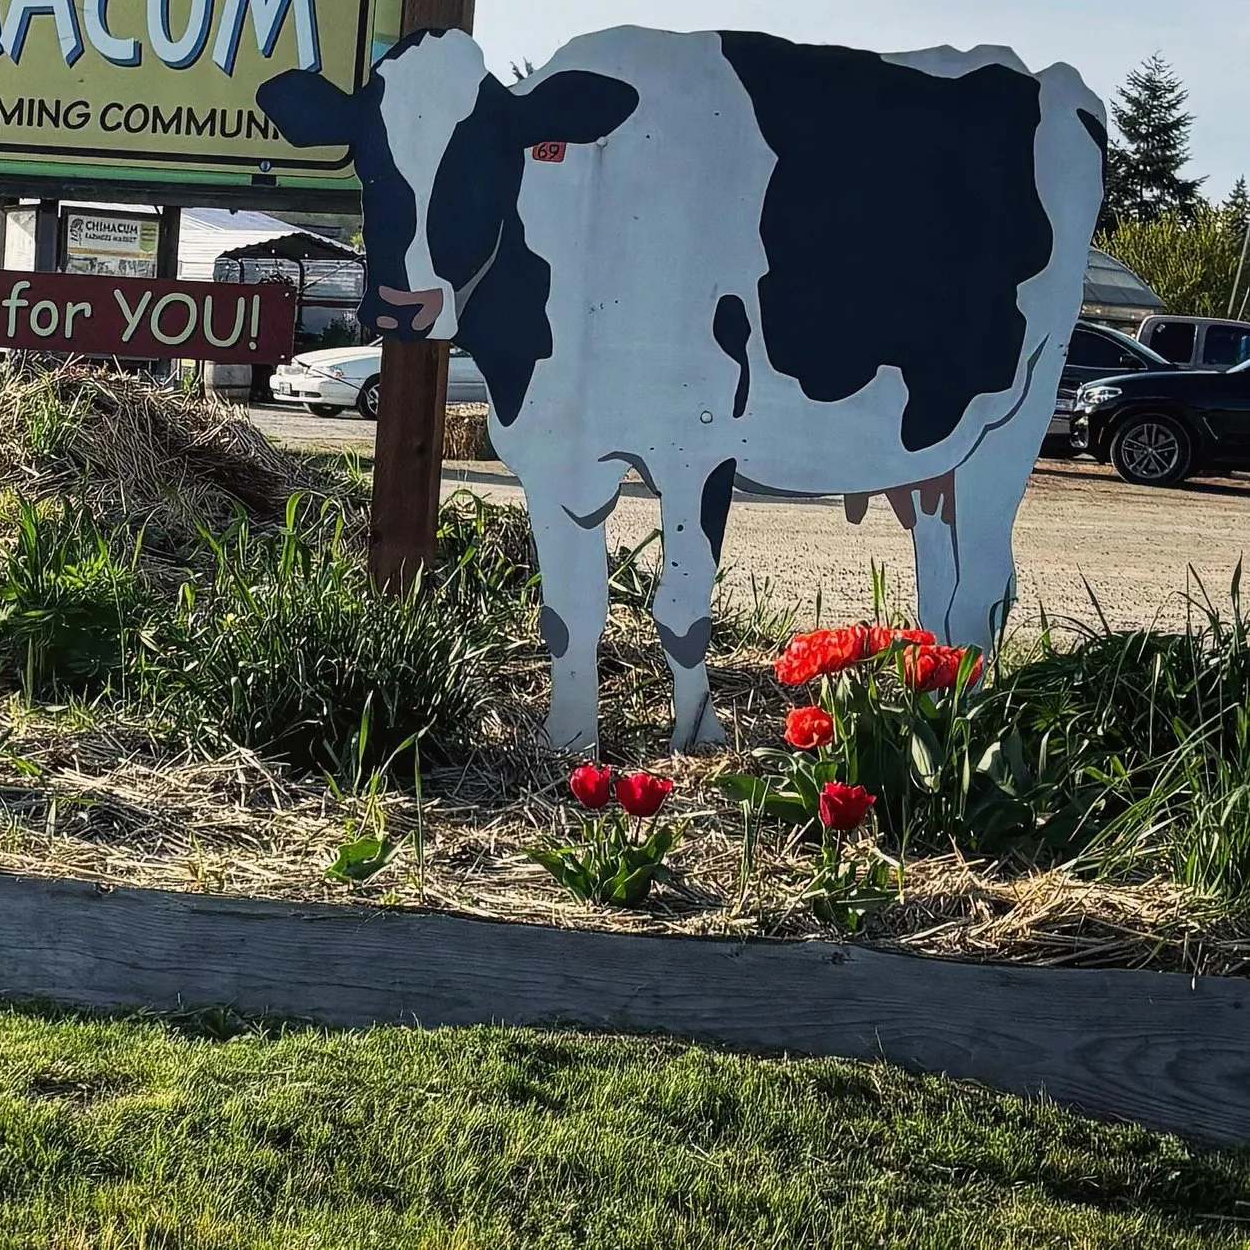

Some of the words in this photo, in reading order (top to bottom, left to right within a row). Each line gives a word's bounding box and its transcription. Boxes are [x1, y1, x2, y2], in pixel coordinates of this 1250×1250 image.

[536, 142, 561, 160] 69
[85, 220, 138, 235] CHIMACUM
[1, 280, 93, 339] for
[112, 288, 261, 351] YOU!
